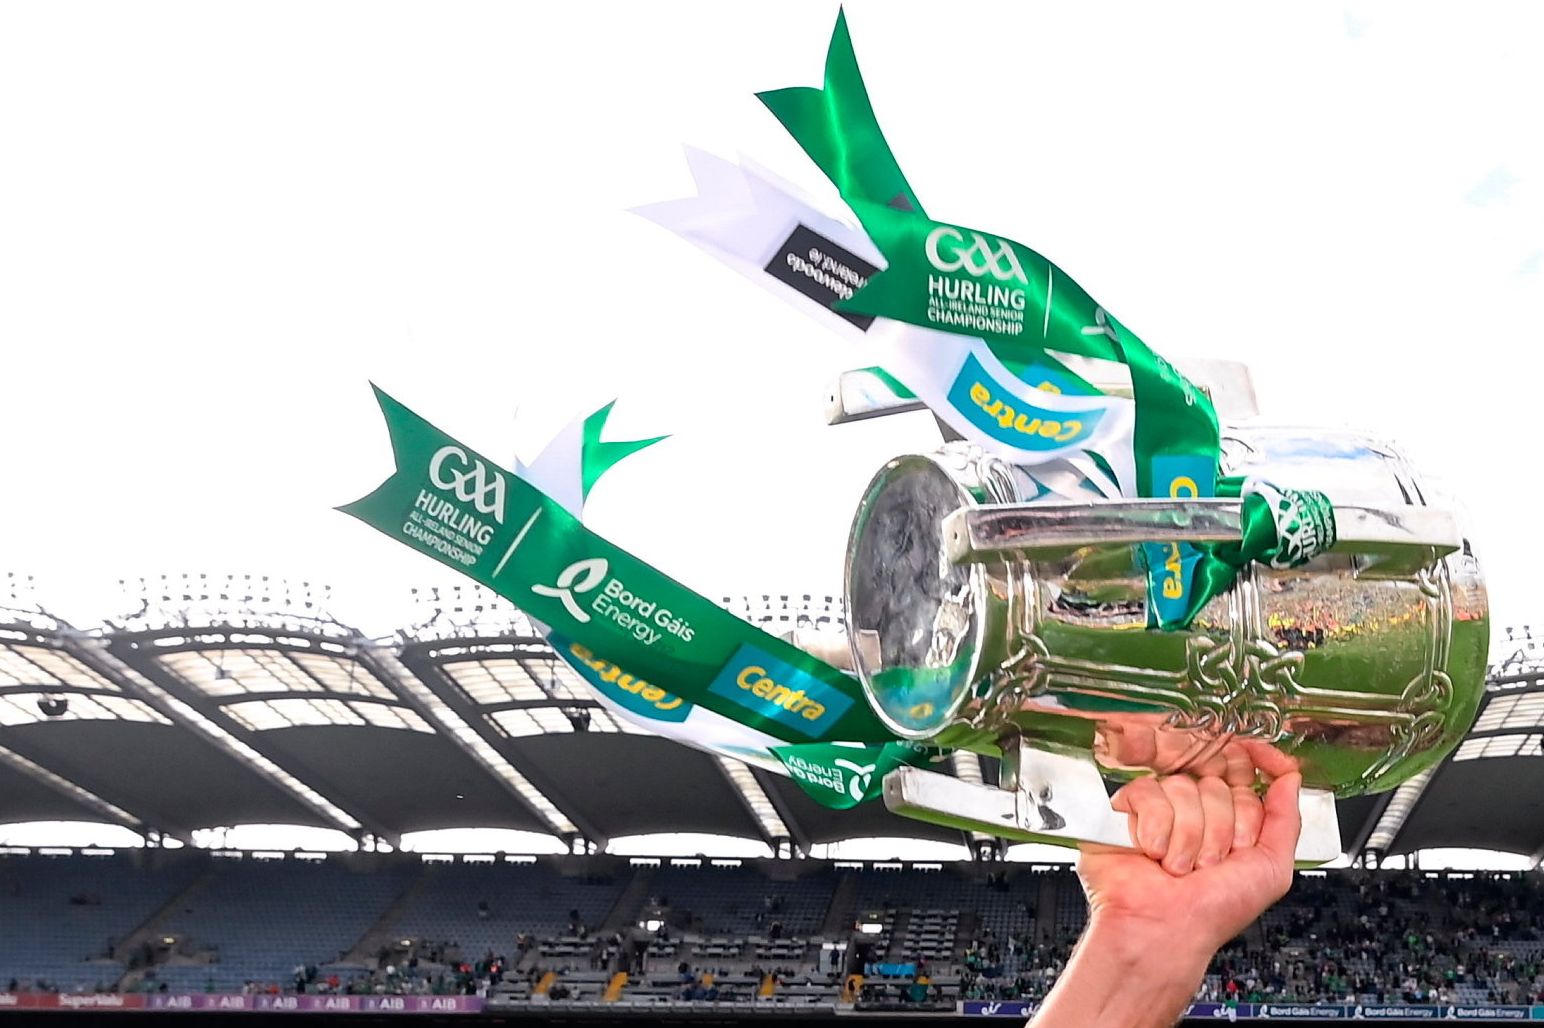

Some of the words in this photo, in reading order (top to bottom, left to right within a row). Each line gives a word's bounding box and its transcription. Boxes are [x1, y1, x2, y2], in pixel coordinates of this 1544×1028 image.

[928, 274, 1026, 310] HURLING
[927, 308, 1024, 336] CHAMPIONSHIP
[929, 296, 989, 317] ALL-IRELAND
[990, 305, 1024, 322] SENIOR
[969, 382, 1083, 442] Centra
[415, 489, 495, 545] HURLING
[402, 521, 477, 566] CHAMPIONSHIP
[409, 512, 457, 543] ALL-IRELAND
[454, 532, 484, 555] SENIOR
[591, 594, 662, 646] Energy
[603, 579, 657, 618] Bord
[654, 608, 695, 642] Gáis
[570, 642, 683, 710] Centra
[736, 665, 826, 721] Centra
[788, 755, 843, 784] Energy
[808, 770, 846, 795] Bord
[166, 994, 192, 1008] AIB
[220, 995, 245, 1008] AIB
[273, 996, 298, 1009] AIB
[326, 997, 350, 1009] AIB
[380, 997, 404, 1010] AIB
[432, 997, 456, 1010] AIB
[981, 1001, 1002, 1015] eir
[1270, 1007, 1290, 1016] Bord
[1310, 1007, 1339, 1018] Energy
[1365, 1007, 1386, 1016] Bord
[1404, 1007, 1433, 1018] Energy
[1457, 1007, 1478, 1016] Bord
[1496, 1007, 1524, 1018] Energy
